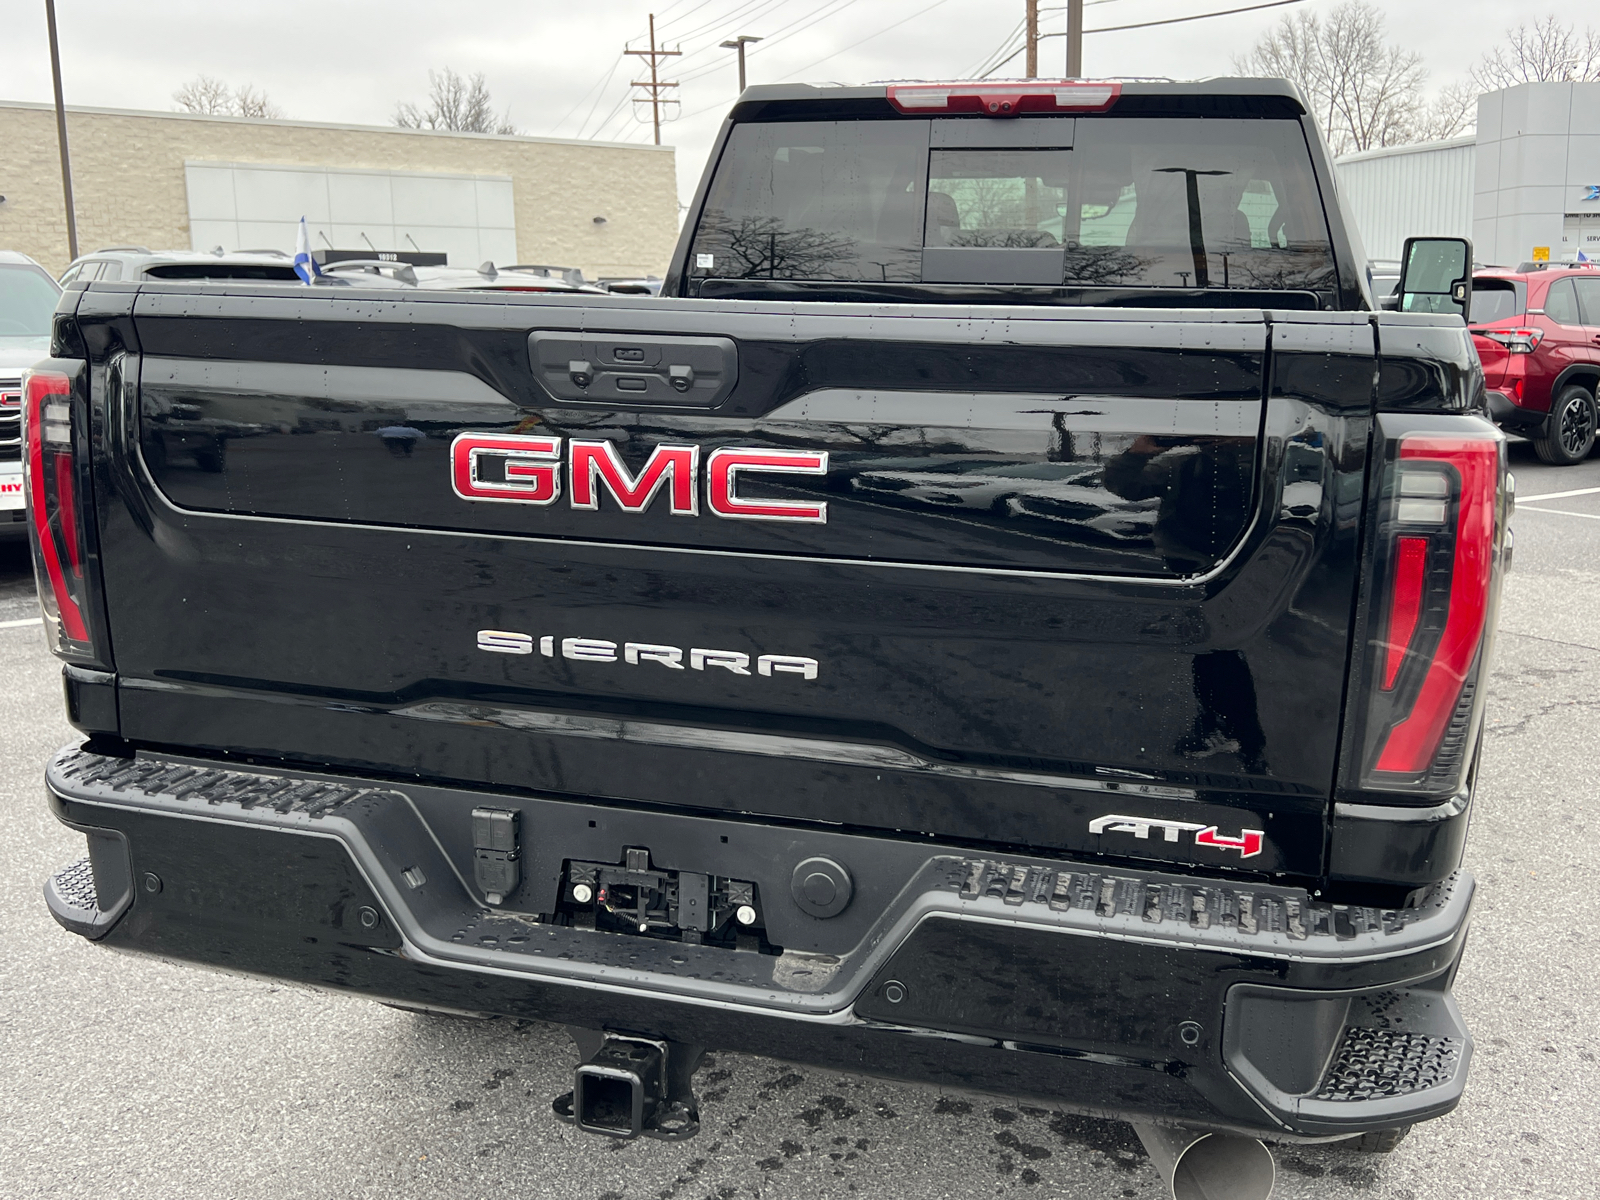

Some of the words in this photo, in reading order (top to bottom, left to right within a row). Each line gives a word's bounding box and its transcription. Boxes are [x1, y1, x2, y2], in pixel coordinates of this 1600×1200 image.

[450, 431, 829, 525] GMC
[477, 629, 819, 680] SIERRA
[1089, 814, 1265, 859] AT4
